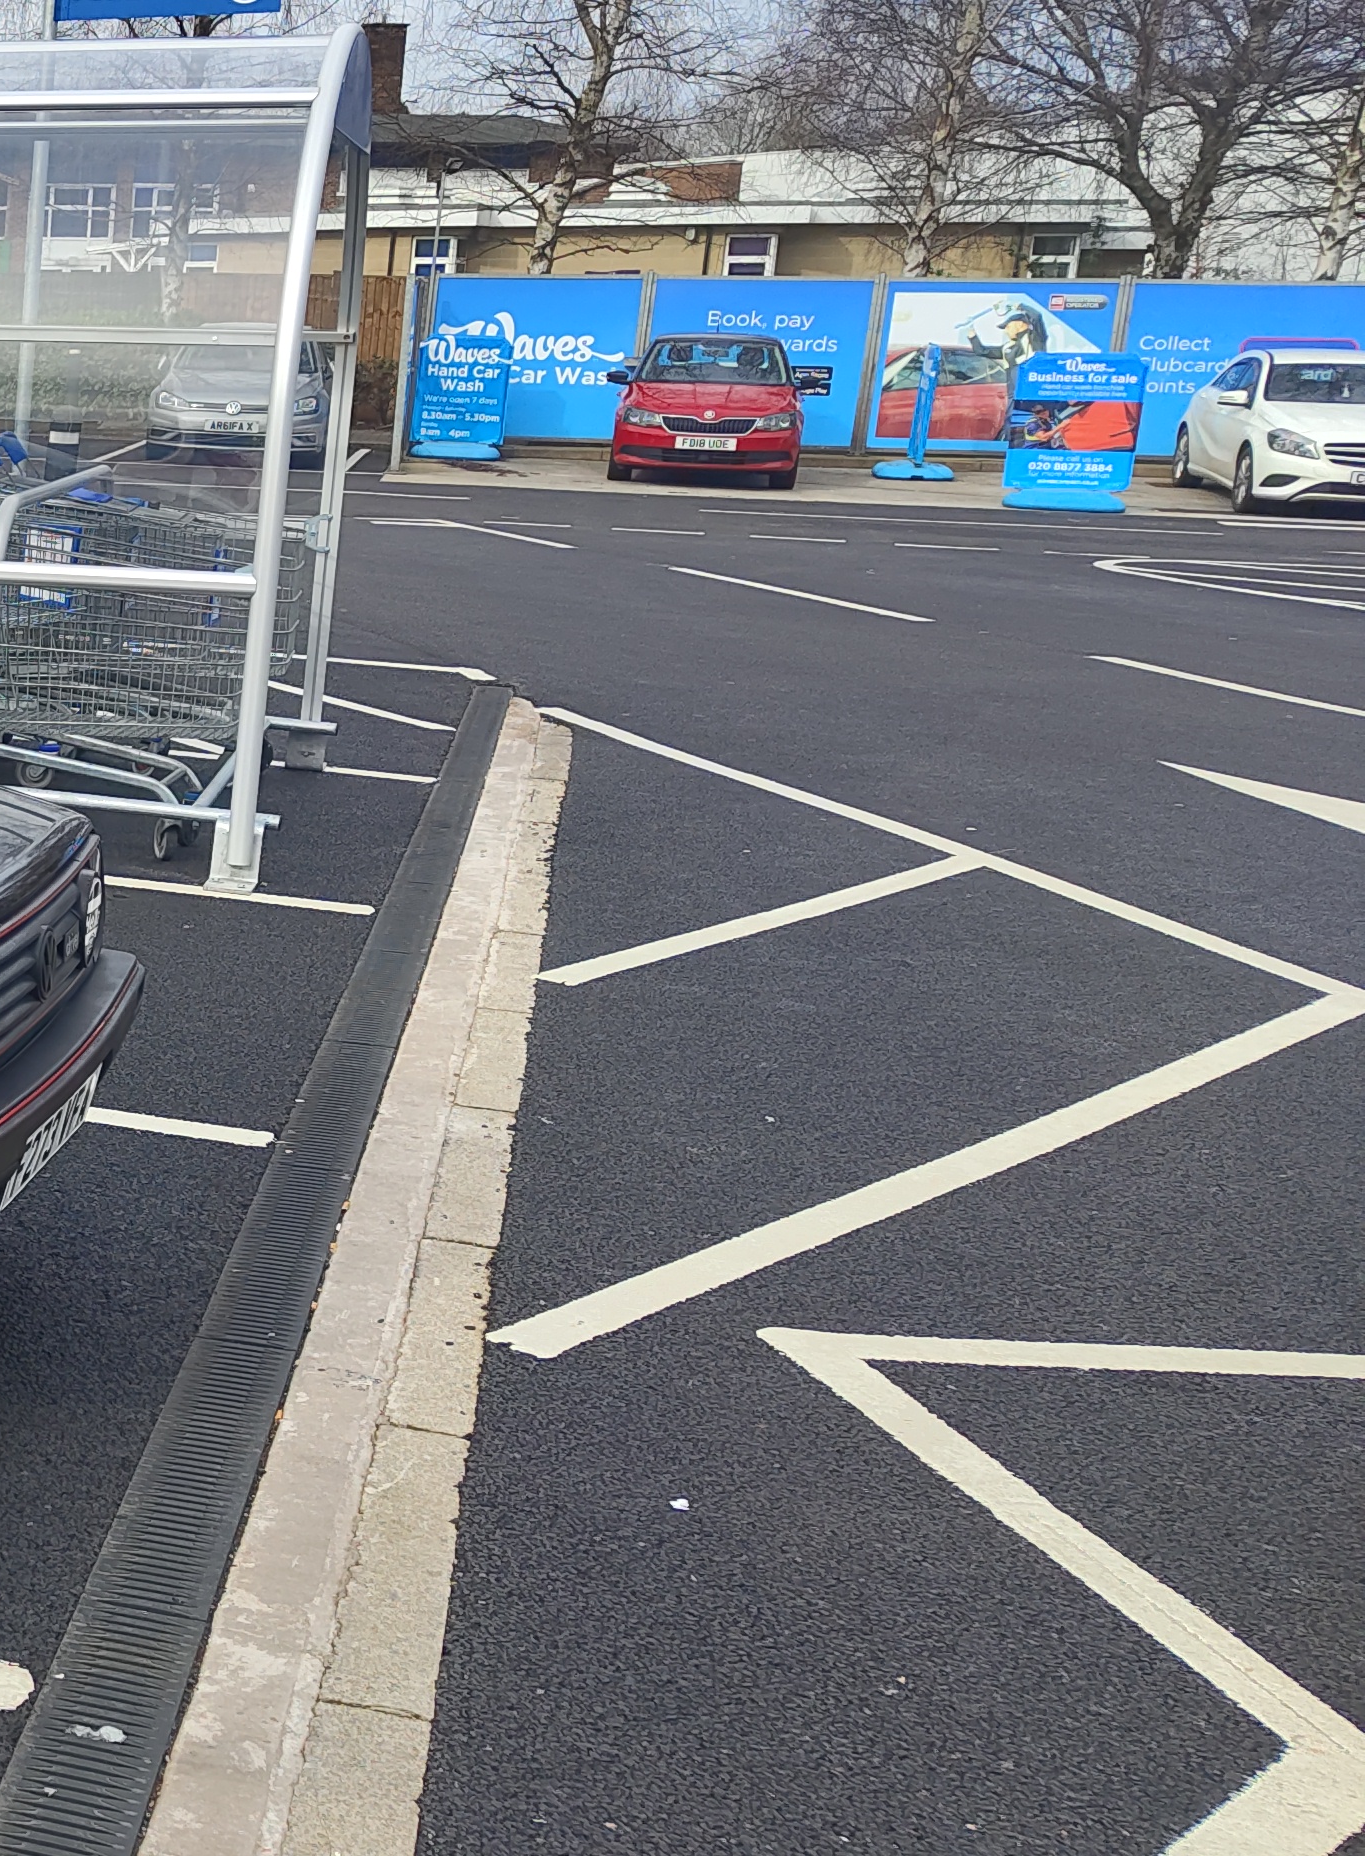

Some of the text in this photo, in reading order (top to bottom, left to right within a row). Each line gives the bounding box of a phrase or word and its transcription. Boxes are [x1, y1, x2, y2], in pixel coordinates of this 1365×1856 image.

[774, 314, 815, 330] pay
[419, 335, 513, 364] Waves
[1139, 335, 1211, 351] Collect
[427, 364, 501, 379] Hand Car
[1057, 357, 1115, 372] Waves
[1140, 356, 1230, 373] lubcard
[555, 366, 617, 385] Was
[1028, 372, 1138, 384] Business for sale
[440, 378, 484, 392] Wash
[1145, 379, 1196, 394] oints
[422, 411, 456, 420] 8.30am
[465, 413, 500, 423] 5.30pm
[682, 438, 706, 448] FD18
[1038, 454, 1064, 462] Please
[1028, 462, 1113, 472] 020 8877 3884
